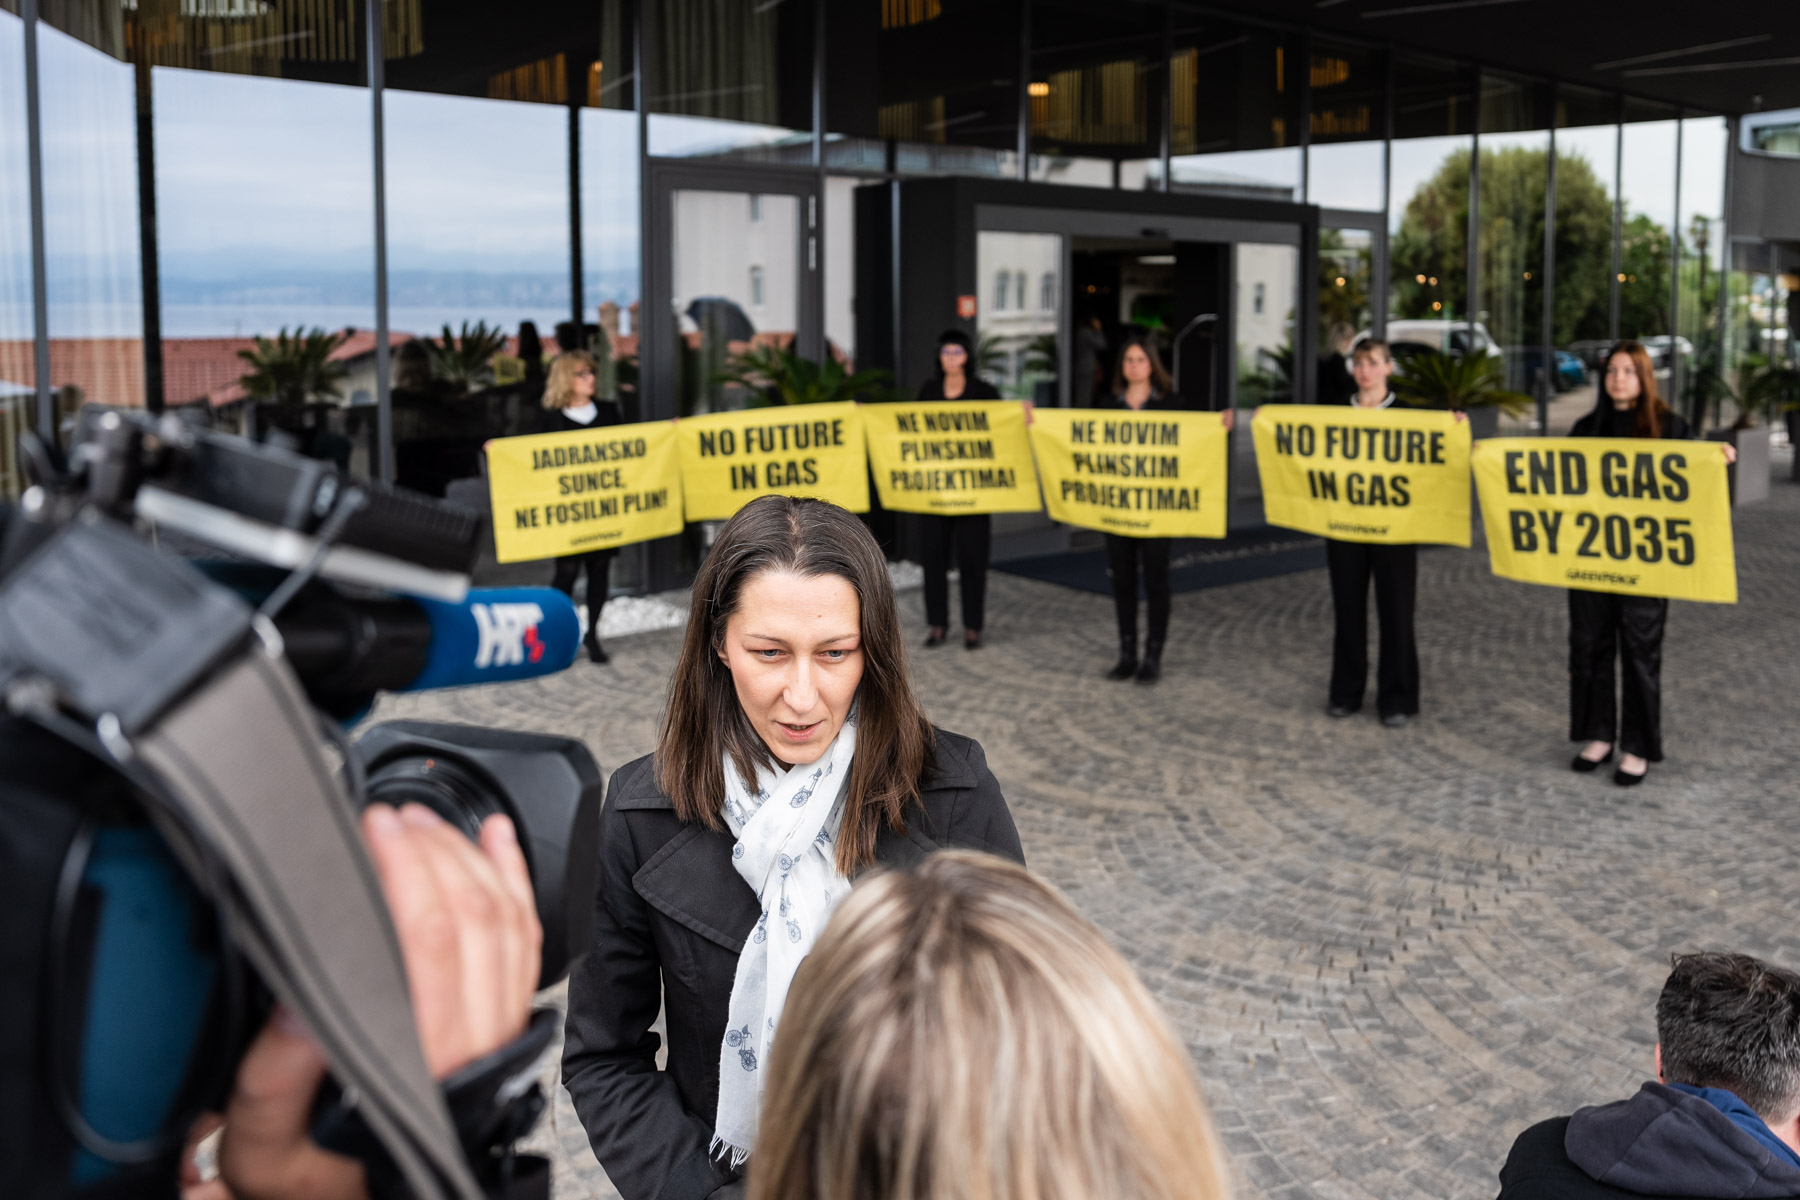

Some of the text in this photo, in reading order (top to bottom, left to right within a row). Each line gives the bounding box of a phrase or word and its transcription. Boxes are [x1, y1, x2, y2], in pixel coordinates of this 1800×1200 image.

[896, 411, 990, 432] NE NOVIM
[1072, 421, 1179, 446] NE NOVIM
[532, 438, 647, 470] JADRANSKO
[699, 420, 844, 457] NO FUTURE
[901, 440, 995, 461] PLINSKIM
[1275, 423, 1446, 464] NO FUTURE
[731, 458, 818, 491] IN GAS
[890, 468, 1016, 491] PROJEKTIMA!
[1073, 452, 1179, 478] PLINSKIM
[1505, 451, 1690, 502] END GAS
[1061, 480, 1199, 511] PROJEKTIMA!
[1307, 469, 1411, 507] IN GAS
[515, 507, 539, 529] NE
[545, 494, 618, 525] FOSILNI
[1509, 510, 1695, 566] BY 2035
